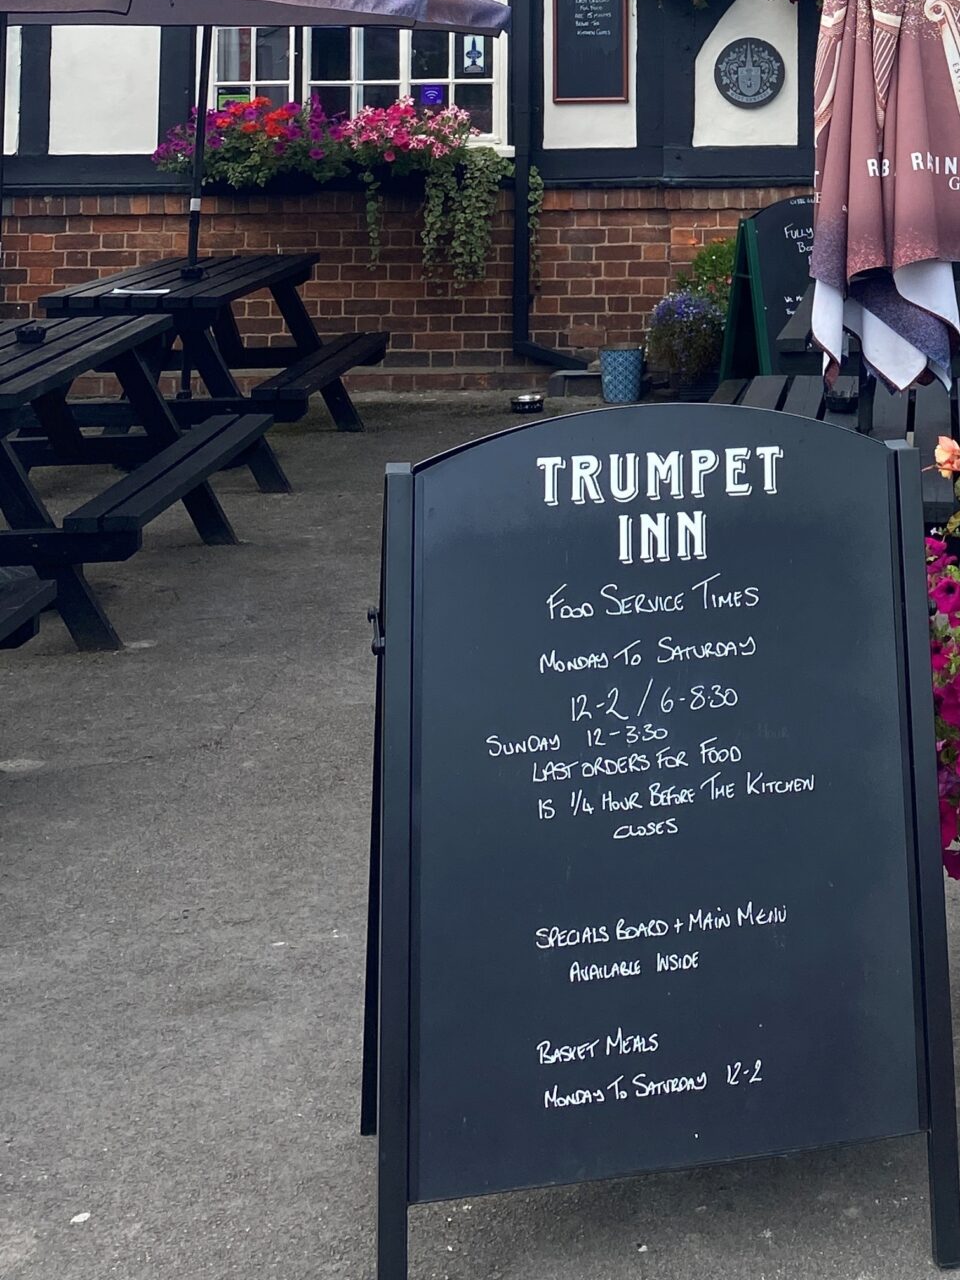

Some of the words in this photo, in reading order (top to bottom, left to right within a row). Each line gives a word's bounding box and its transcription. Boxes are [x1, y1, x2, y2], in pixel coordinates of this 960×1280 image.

[784, 223, 814, 239] FULLY
[536, 446, 784, 506] TRUMPET
[618, 511, 708, 564] INN
[546, 583, 595, 620] FOOD
[600, 583, 685, 616] SERVICE
[692, 572, 760, 610] TIMES
[539, 649, 609, 674] MONDAY
[613, 639, 642, 666] TO
[656, 635, 757, 664] SATURDAY
[571, 687, 630, 722] 12-2
[485, 734, 561, 757] SUNDAY
[532, 760, 579, 783] LAST
[581, 753, 651, 778] ORDERS
[655, 746, 689, 769] FOR
[700, 736, 742, 765] FOOD
[538, 798, 556, 820] IS
[570, 788, 595, 817] 1/4
[601, 790, 644, 812] HOUR
[648, 782, 696, 807] BEFORE
[700, 771, 735, 801] THE
[746, 771, 815, 795] KITCHEN
[612, 818, 679, 839] CLOSES
[535, 926, 610, 949] SPECIALS
[615, 918, 669, 941] BOARD
[688, 906, 731, 932] MAIN
[736, 900, 788, 927] MENU
[569, 959, 641, 983] AVAILABLE
[656, 951, 700, 973] INSIDE
[536, 1038, 600, 1065] BASKET
[605, 1026, 659, 1056] MEALS
[544, 1084, 605, 1109] MONDAY
[606, 1074, 628, 1100] TO
[631, 1072, 708, 1098] SATURDAY
[726, 1059, 763, 1086] 12-2
